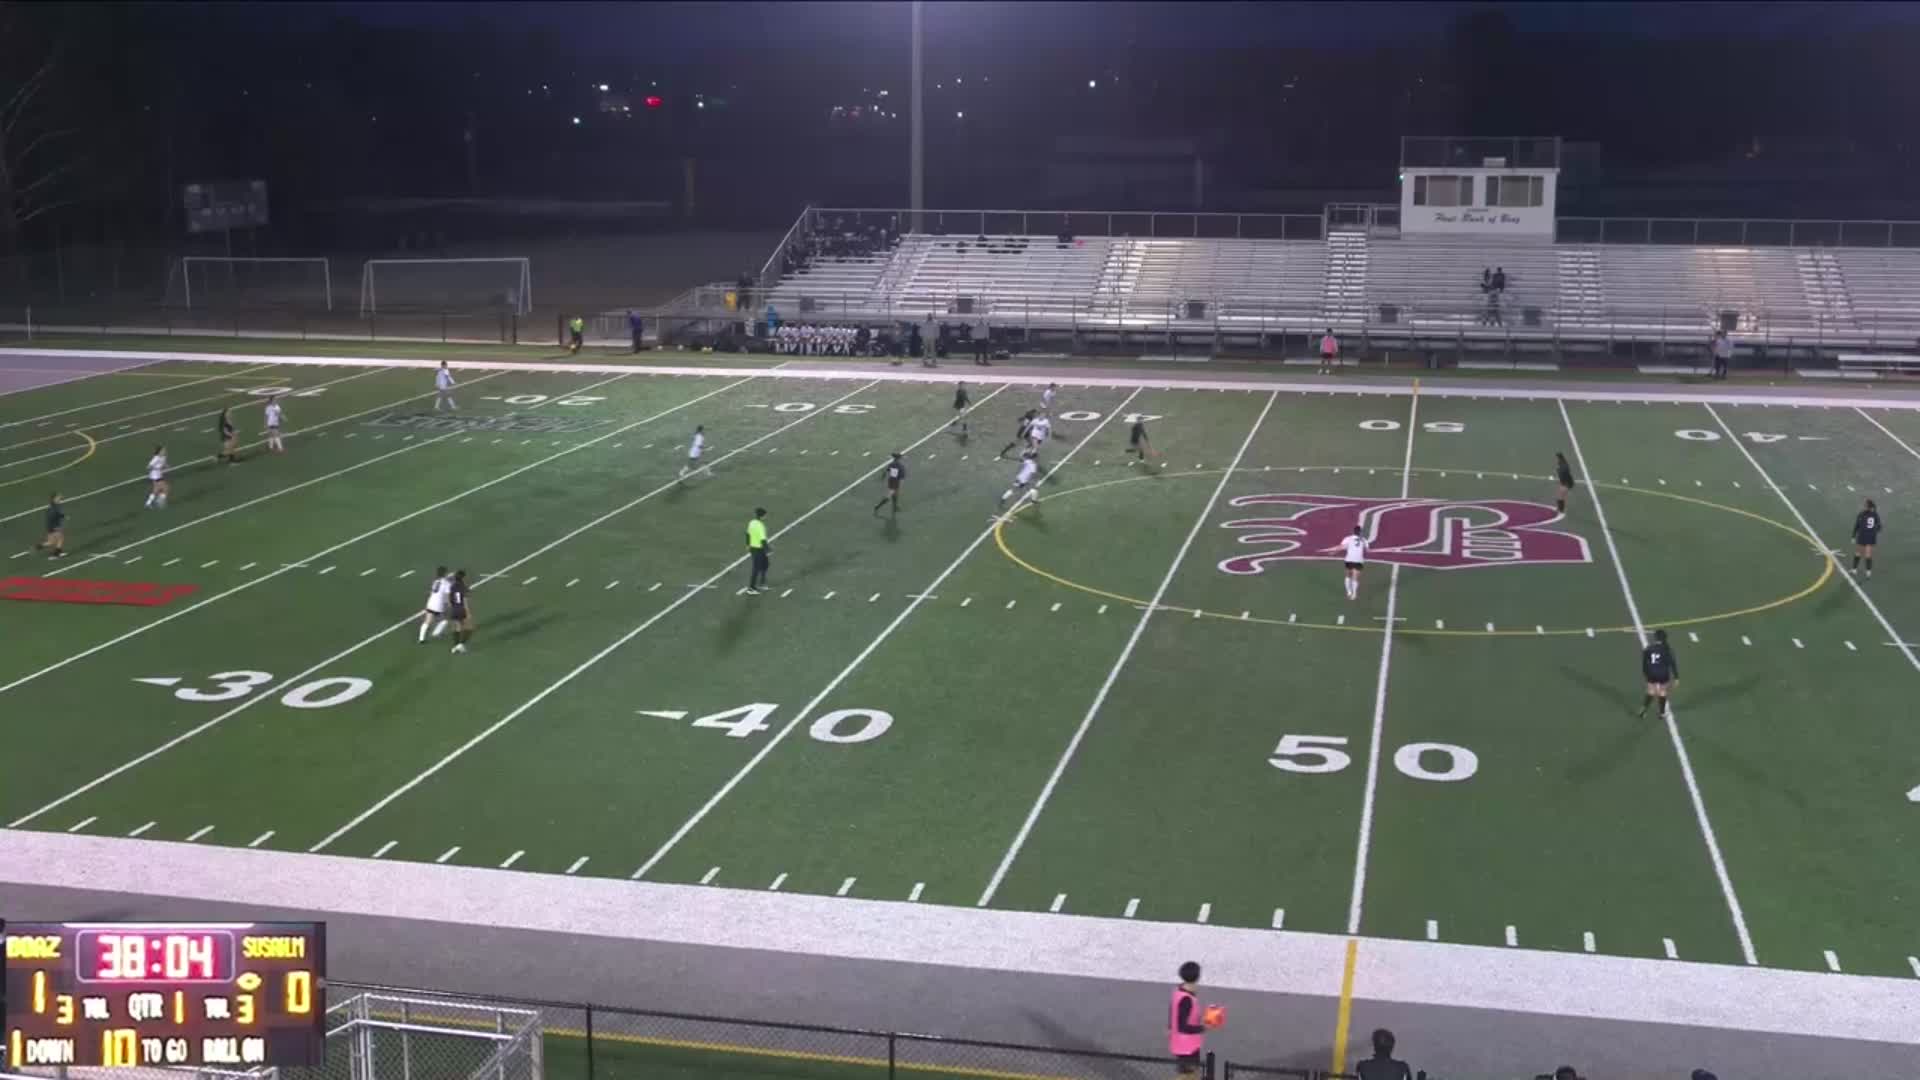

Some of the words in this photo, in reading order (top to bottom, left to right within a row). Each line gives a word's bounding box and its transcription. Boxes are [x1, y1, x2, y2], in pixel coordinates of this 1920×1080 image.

[1867, 517, 1875, 529] 9
[174, 669, 373, 708] 30
[691, 702, 894, 743] 40
[1267, 734, 1478, 781] 50
